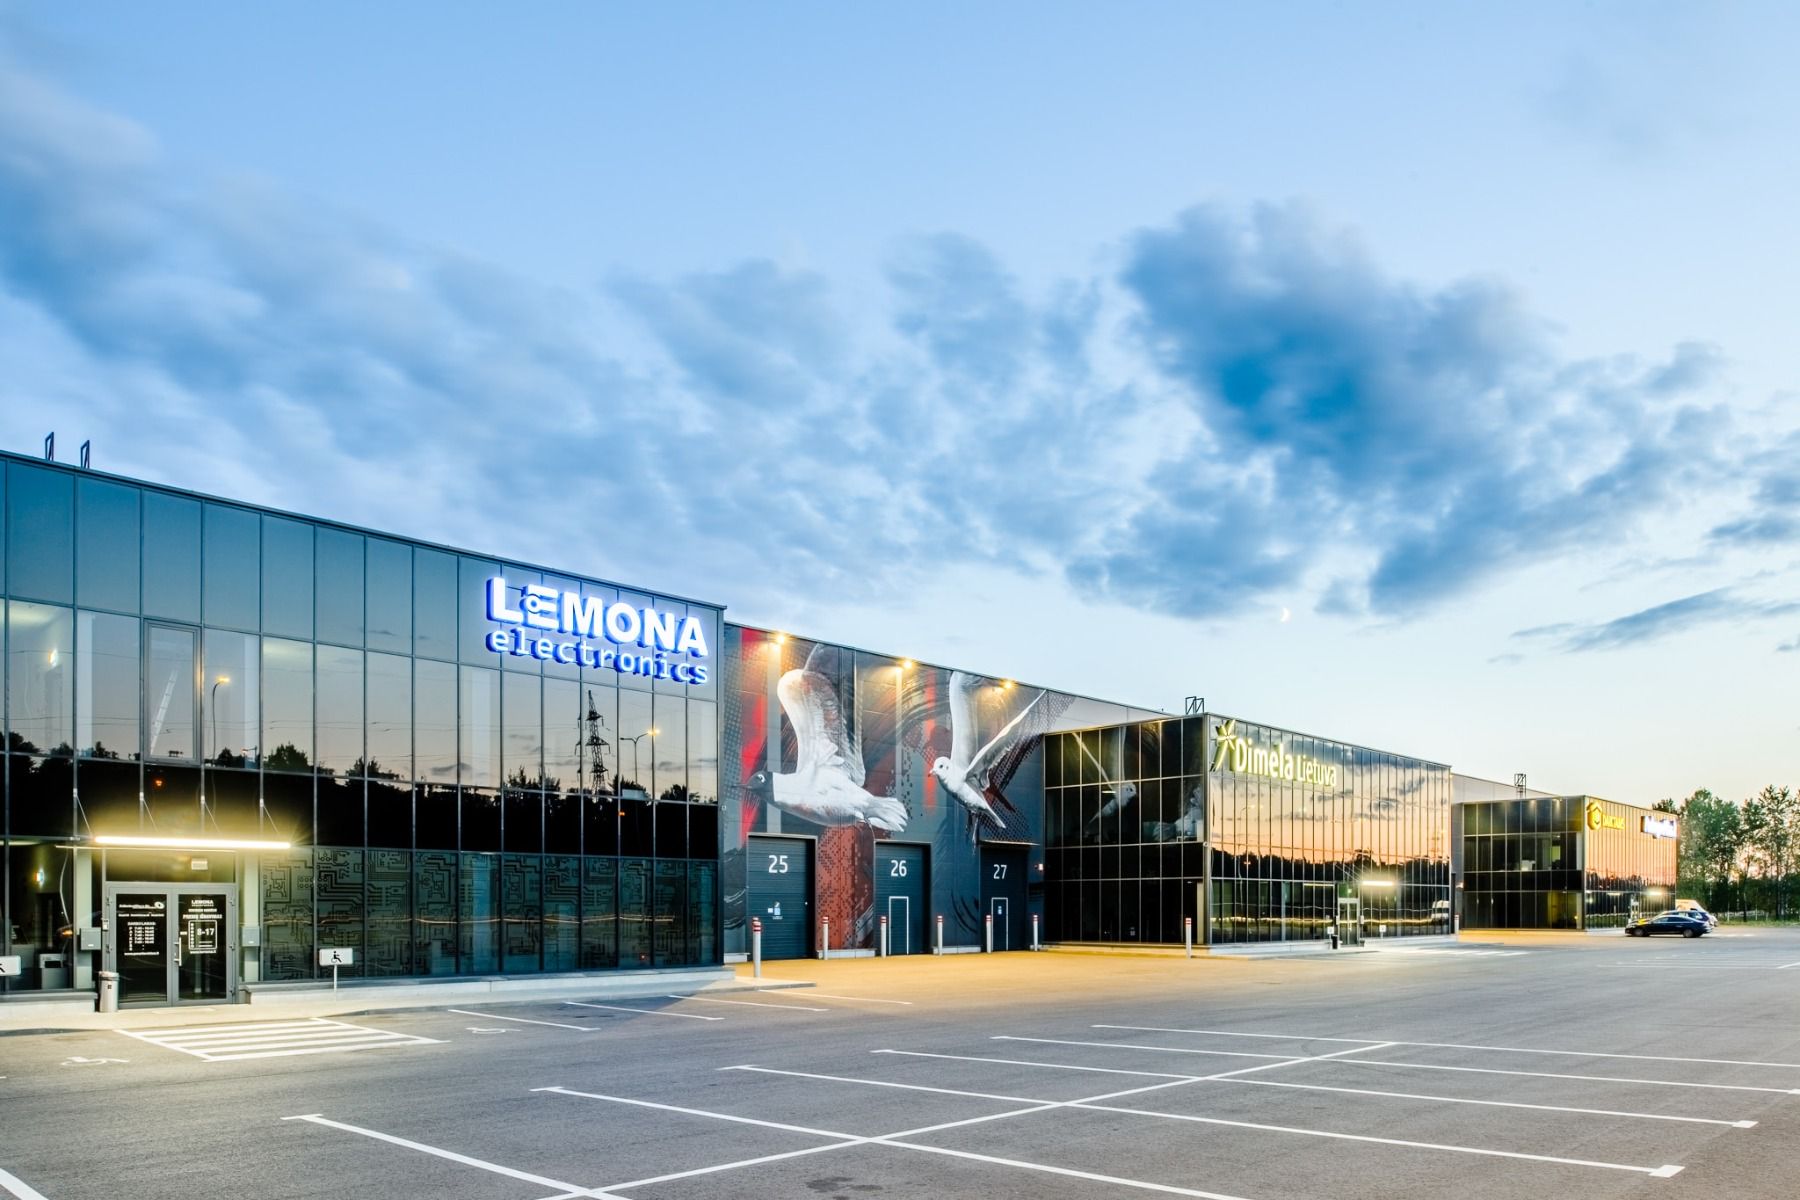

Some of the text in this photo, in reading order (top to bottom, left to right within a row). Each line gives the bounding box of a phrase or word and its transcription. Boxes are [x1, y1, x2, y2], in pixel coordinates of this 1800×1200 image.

[487, 576, 709, 658] LEMONA
[487, 626, 709, 684] electronics
[1233, 738, 1337, 787] Dimela Lietuva
[768, 855, 788, 873] 25
[890, 860, 907, 877] 26
[993, 864, 1007, 879] 27
